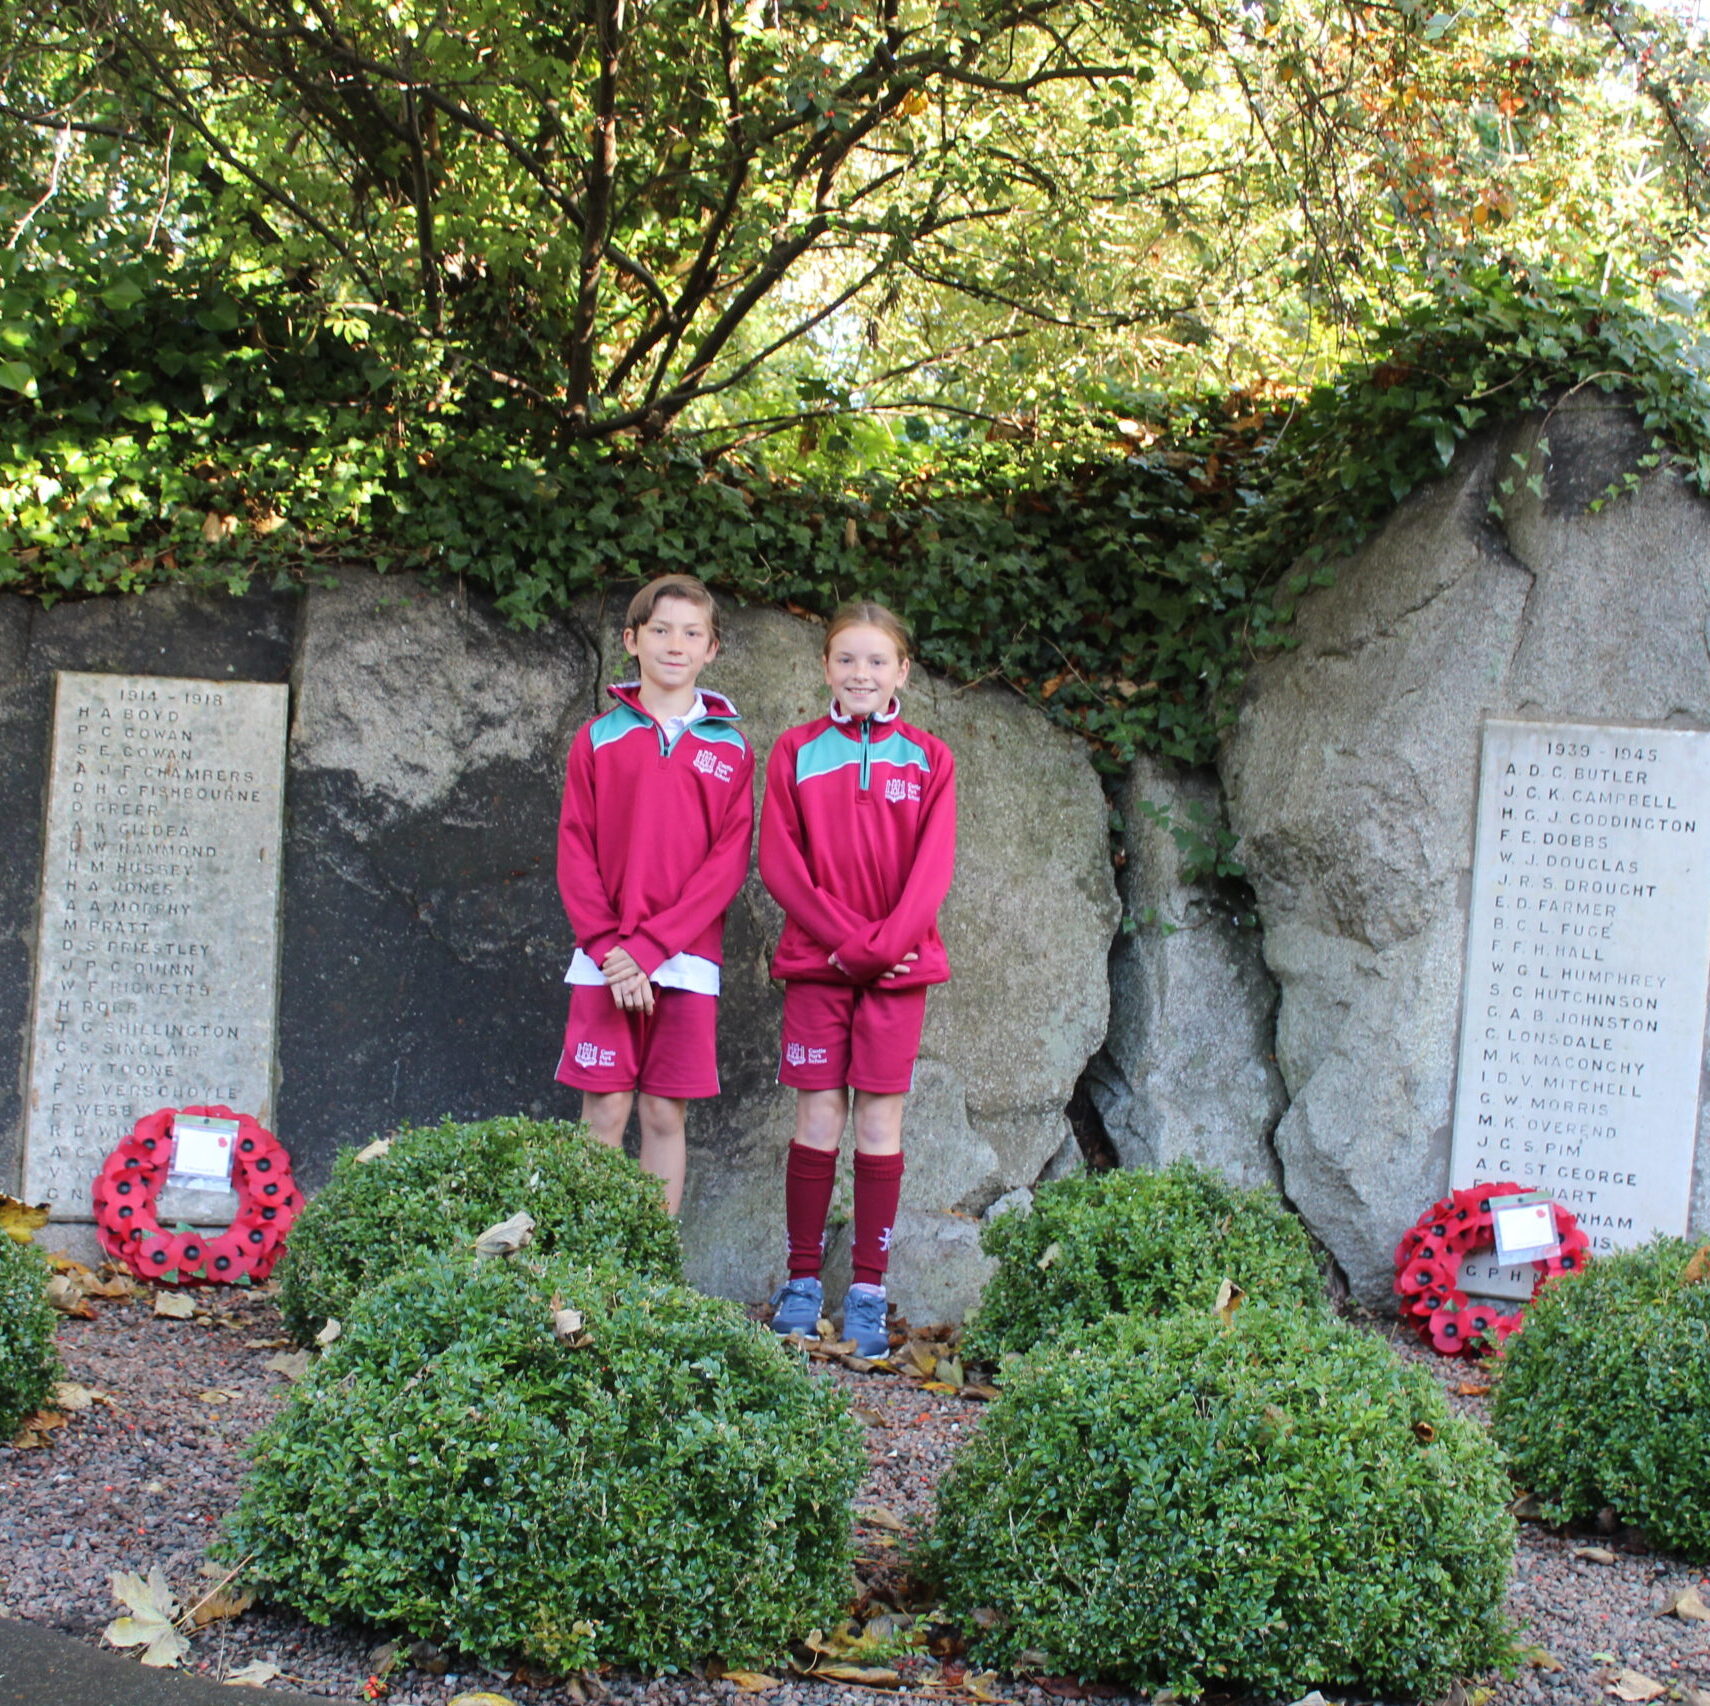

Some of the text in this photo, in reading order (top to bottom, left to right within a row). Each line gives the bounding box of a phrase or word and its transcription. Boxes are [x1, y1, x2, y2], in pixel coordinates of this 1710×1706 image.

[120, 690, 158, 700] 1914
[185, 694, 223, 705] 1918
[124, 710, 179, 722] BOYD
[125, 728, 192, 742] COWAN
[123, 747, 192, 759] COWAN
[1547, 742, 1590, 757] 1939
[1615, 747, 1657, 762] 1945
[145, 767, 254, 782] CHAMBERS
[1575, 768, 1648, 784] BUTLER
[140, 786, 261, 802] FISHBOURNE
[1573, 790, 1677, 809] CAMPBELL
[1571, 814, 1696, 832] CODDINGTON
[1544, 832, 1608, 849] DOBBS
[119, 843, 216, 857] HAMMOND
[1547, 856, 1639, 873] DOUGLAS
[1565, 880, 1657, 897] DROUGHT
[1539, 899, 1616, 916] FARMER
[89, 922, 150, 934] PRATT
[1556, 945, 1604, 961] HALL
[1562, 968, 1666, 988] HUMPHREY
[111, 982, 210, 995] RICKETTS
[1535, 987, 1658, 1010] HUTCHINSON
[1556, 1011, 1658, 1032] JOHNSTON
[106, 1022, 239, 1039] SHILLINGTON
[1508, 1030, 1613, 1051] LONSDALE
[103, 1043, 200, 1057] SINCLAIR
[108, 1064, 175, 1076] TOONE
[1534, 1054, 1645, 1075] MACONCHY
[1544, 1076, 1643, 1098] MITCHELL
[77, 1105, 133, 1116] WEBB
[1531, 1098, 1609, 1116] MORRIS
[1528, 1119, 1617, 1139] OVEREND
[1545, 1143, 1581, 1157] PIM
[1558, 1166, 1637, 1185] GEORGE
[1575, 1212, 1633, 1229] NHAM
